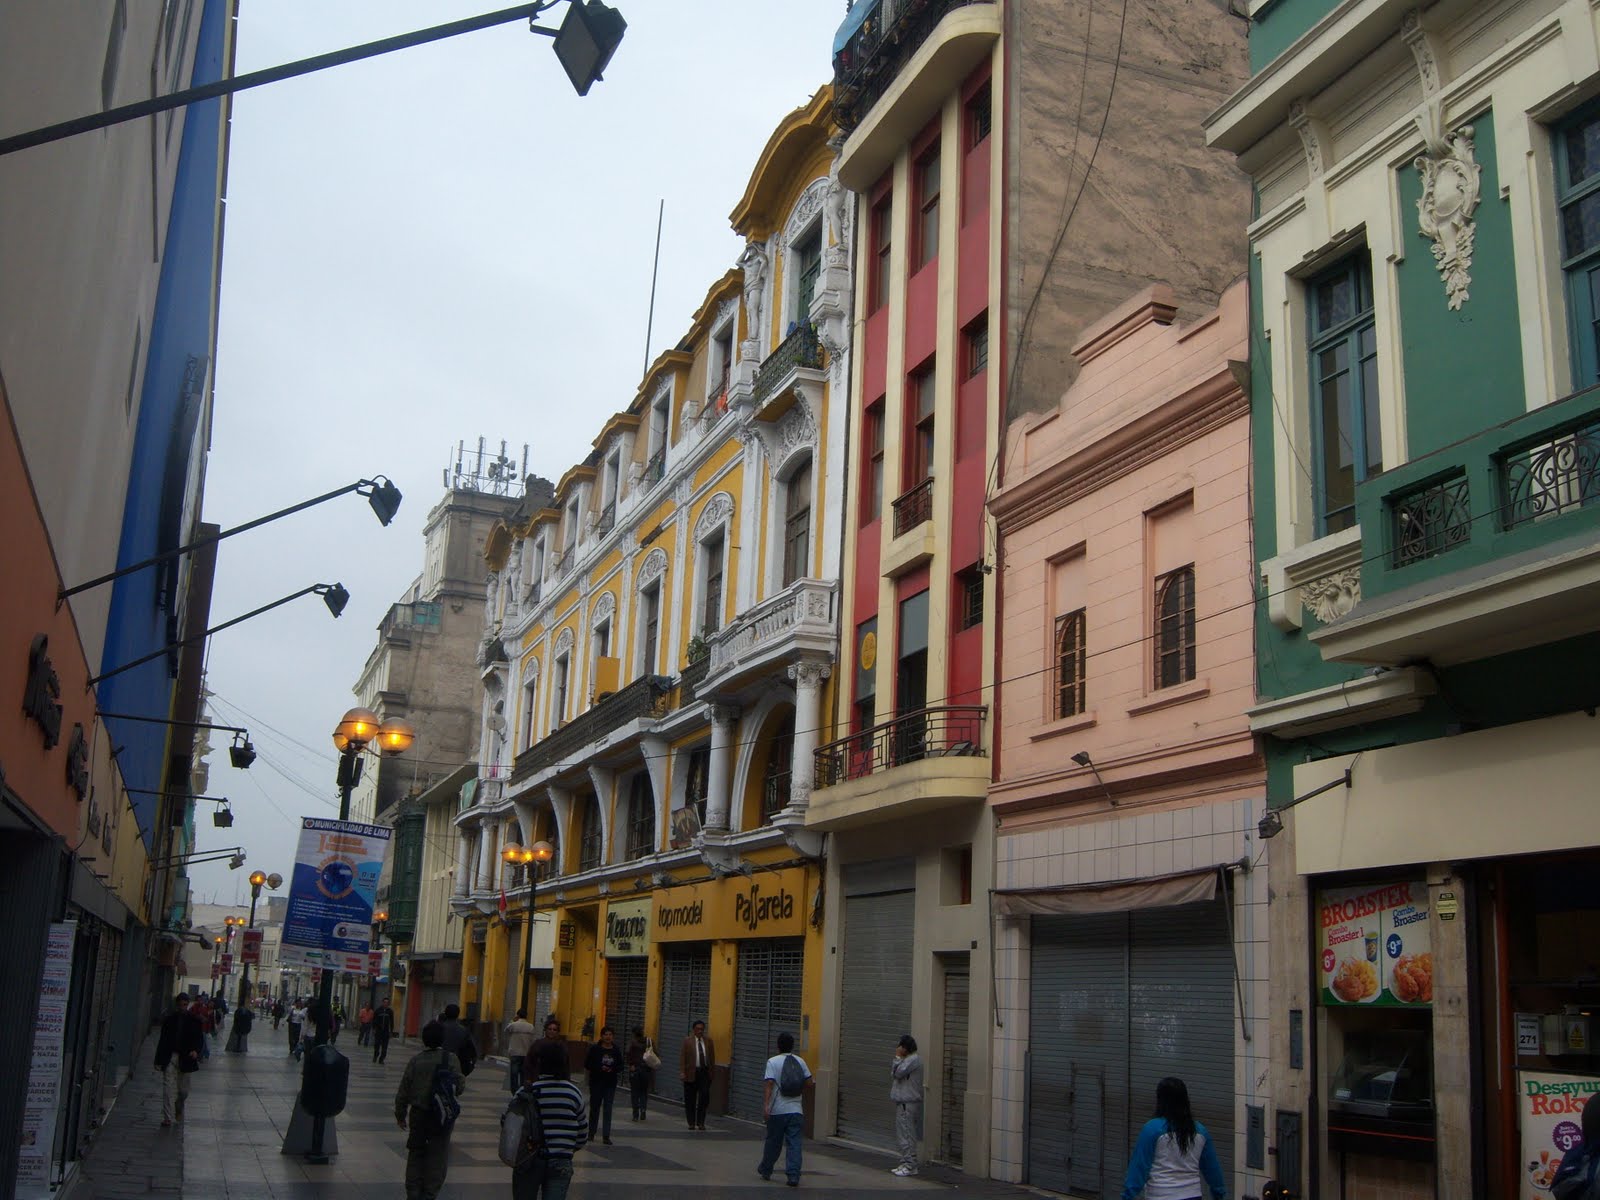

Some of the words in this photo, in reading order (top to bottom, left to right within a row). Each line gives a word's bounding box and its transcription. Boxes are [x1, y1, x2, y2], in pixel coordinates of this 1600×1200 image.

[314, 819, 362, 835] MUNICIPALIDAD
[363, 826, 374, 835] DE
[373, 828, 390, 838] LIMA
[1320, 882, 1413, 928] BROASTER
[1392, 906, 1415, 917] Combo
[1393, 911, 1427, 928] Broaster
[1328, 925, 1348, 936] Combo
[1328, 930, 1360, 946] Broaster
[1520, 1034, 1537, 1045] 271
